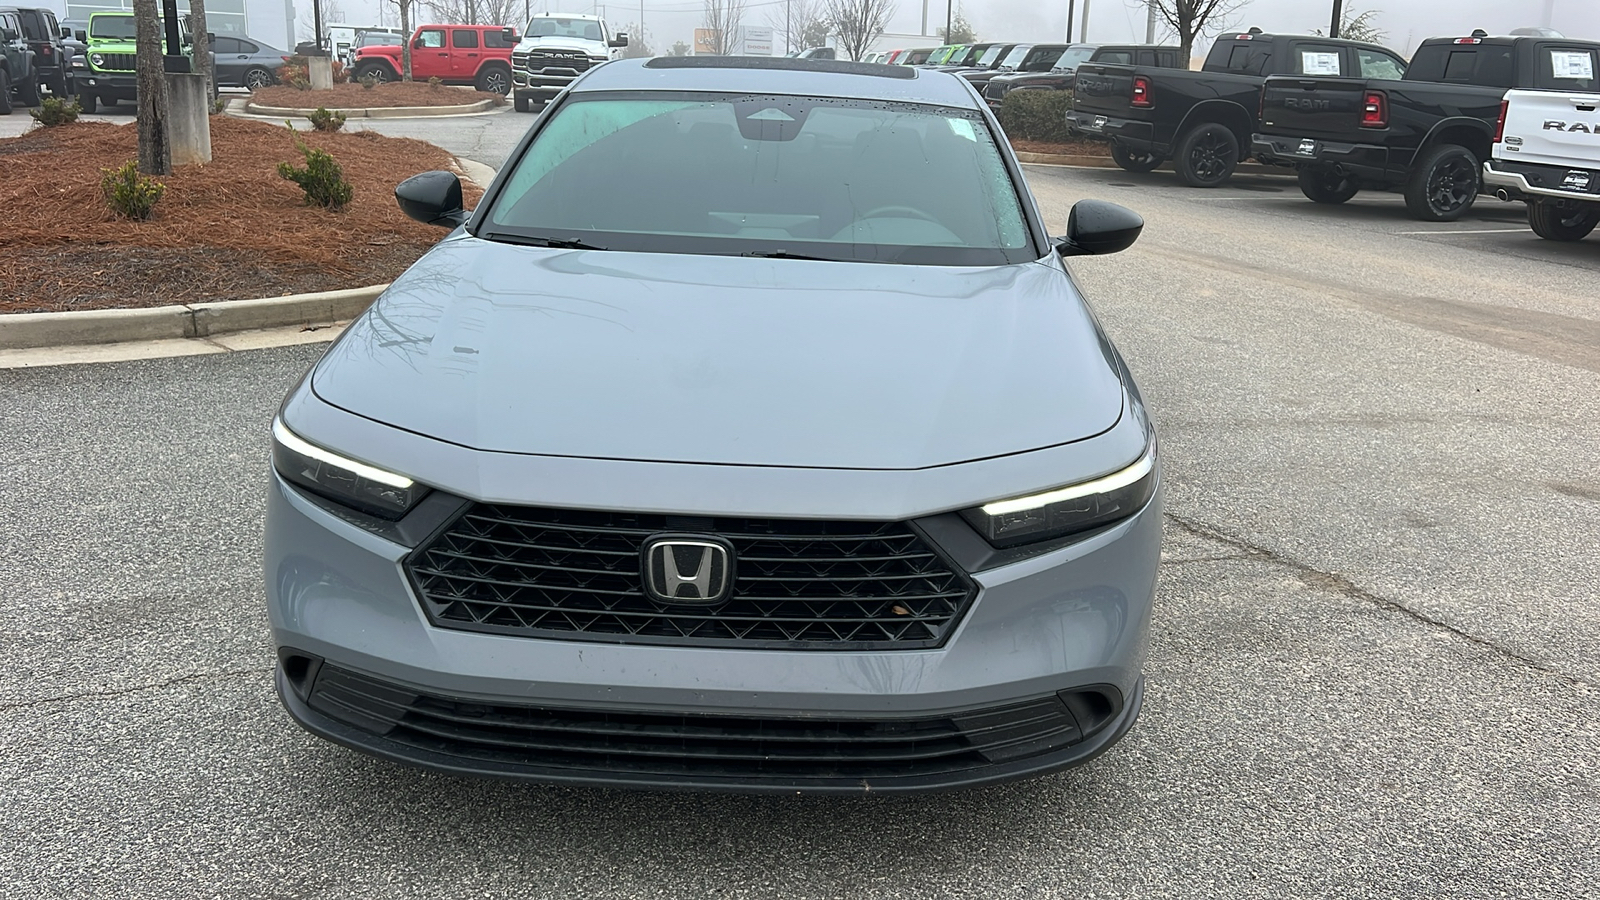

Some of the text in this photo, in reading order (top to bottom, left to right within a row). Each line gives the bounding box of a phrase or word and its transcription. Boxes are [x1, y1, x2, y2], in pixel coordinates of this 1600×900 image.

[697, 36, 717, 45] Jee
[1284, 97, 1330, 109] RAM
[1543, 119, 1600, 134] RA
